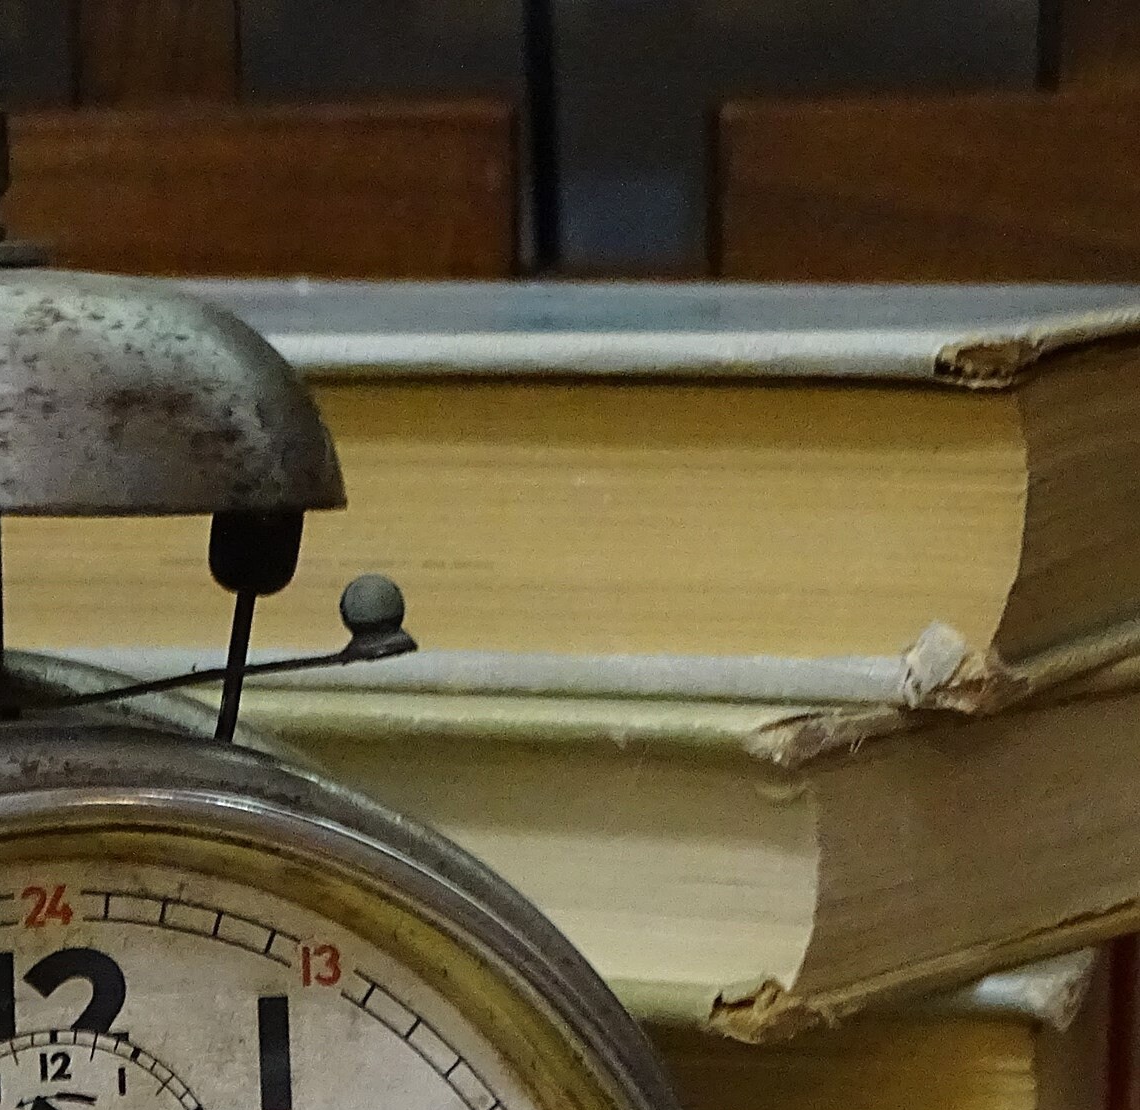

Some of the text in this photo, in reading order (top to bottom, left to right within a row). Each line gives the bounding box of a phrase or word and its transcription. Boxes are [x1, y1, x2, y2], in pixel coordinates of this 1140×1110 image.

[21, 884, 73, 928] 24
[300, 945, 341, 986] 13
[40, 1052, 72, 1082] 12
[118, 1067, 126, 1096] 1
